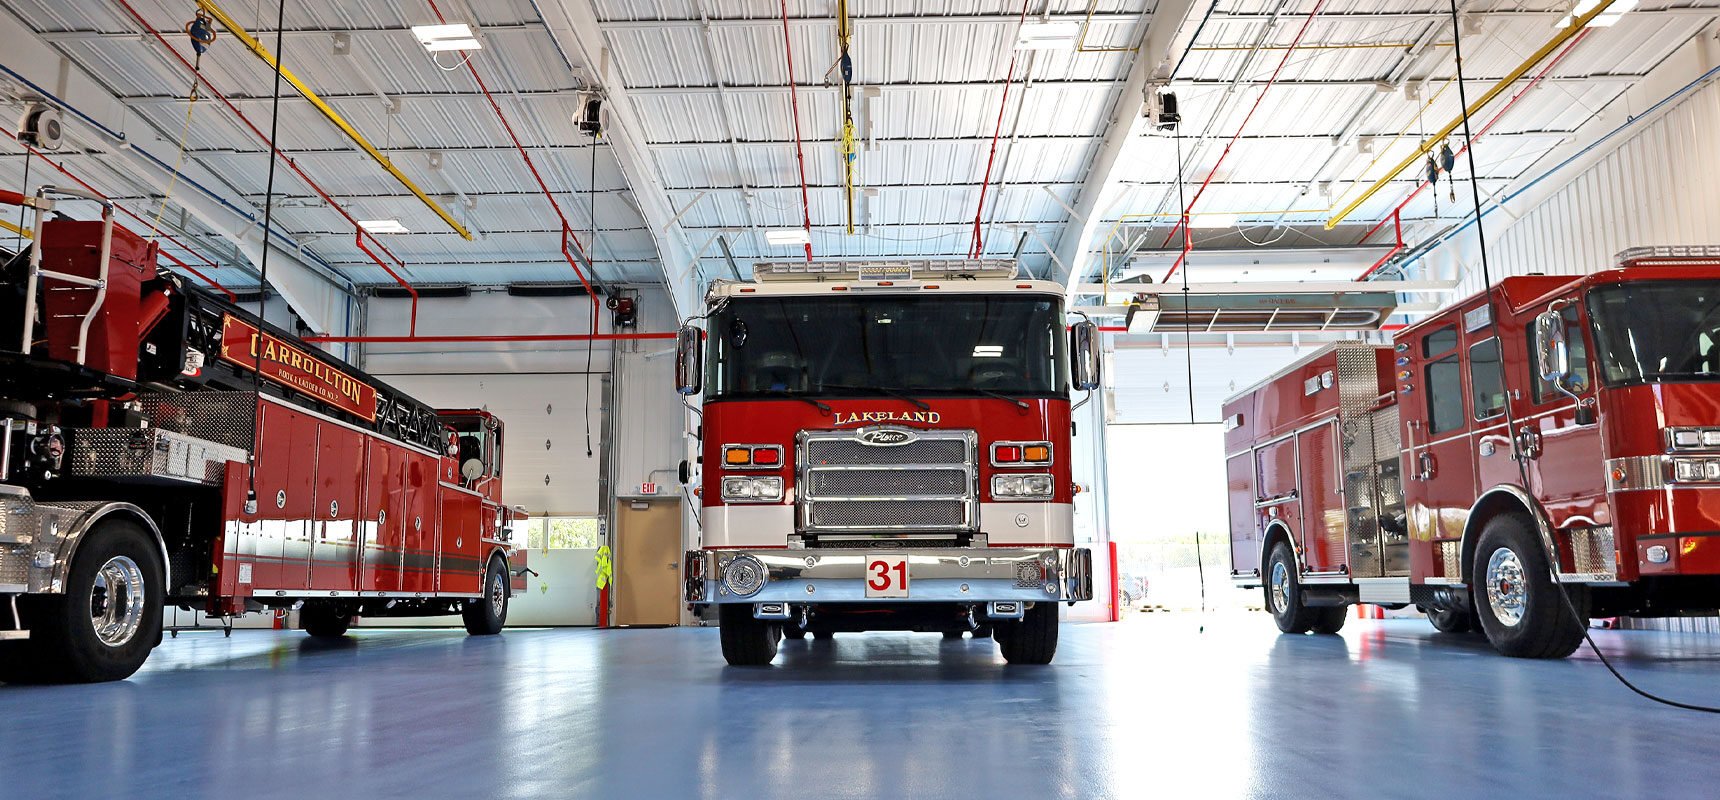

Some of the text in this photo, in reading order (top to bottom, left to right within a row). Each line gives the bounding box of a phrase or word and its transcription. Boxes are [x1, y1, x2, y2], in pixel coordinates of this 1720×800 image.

[250, 333, 362, 405] CARROLLTON
[298, 377, 319, 393] LADDER
[834, 411, 941, 425] LAKELAND
[869, 432, 904, 443] Pierce
[642, 483, 655, 493] EXIT
[868, 560, 907, 591] 31
